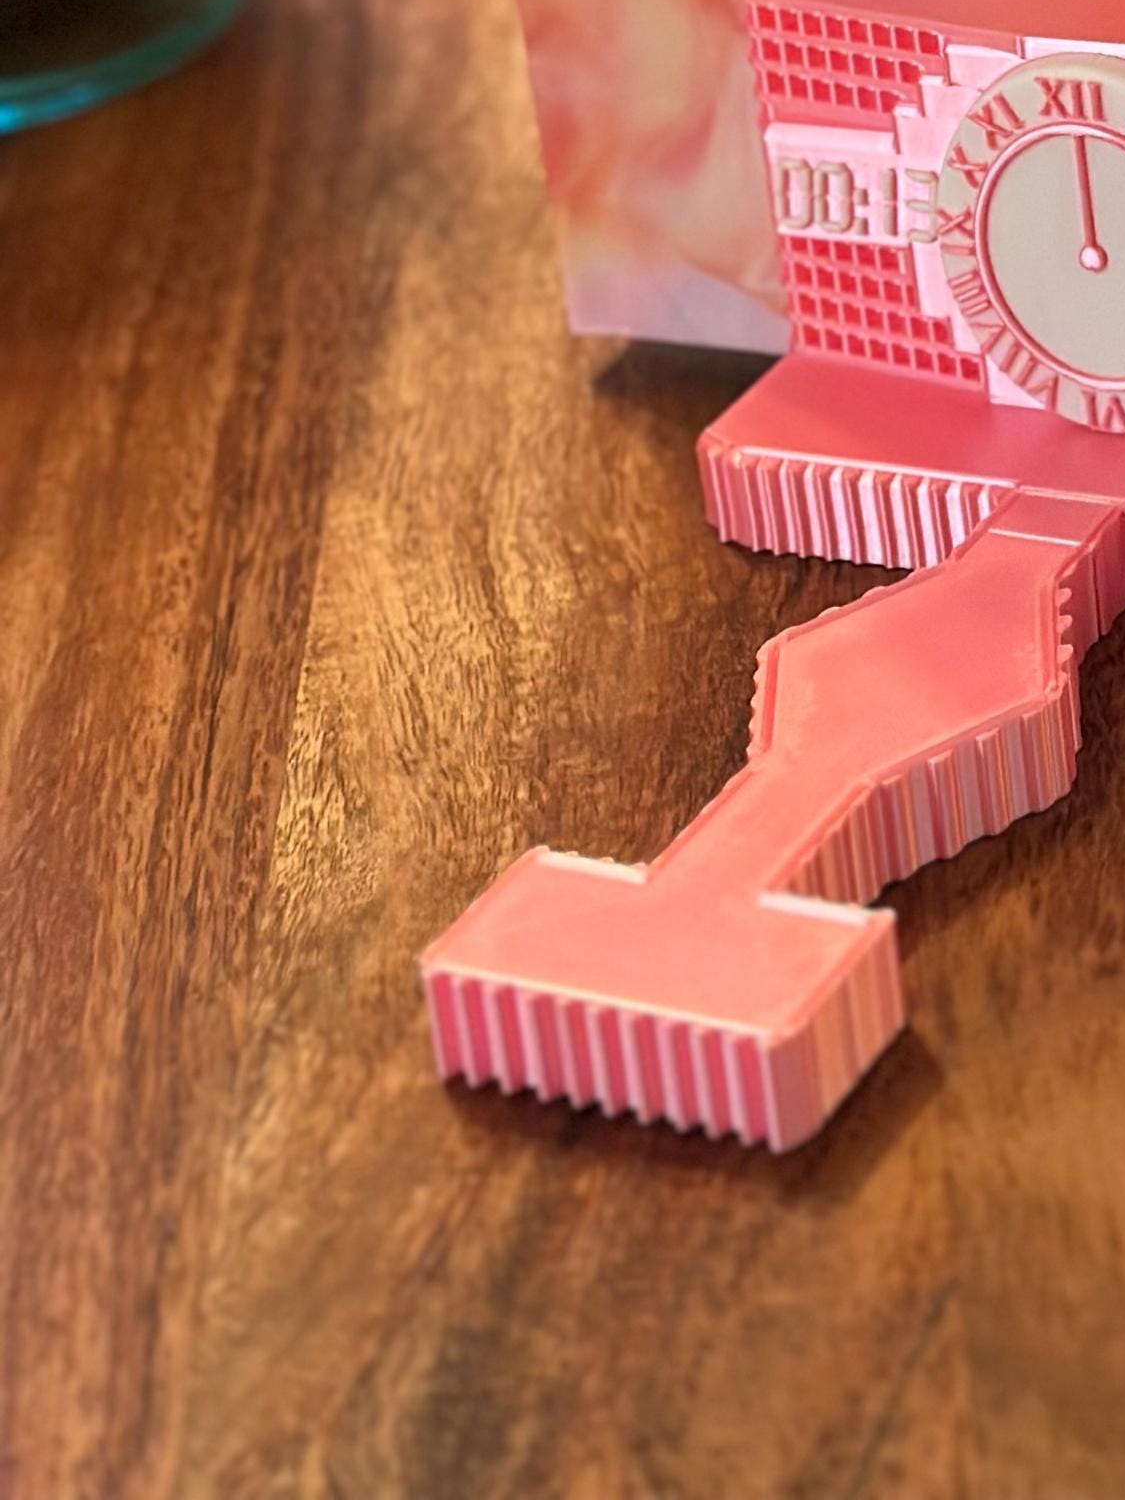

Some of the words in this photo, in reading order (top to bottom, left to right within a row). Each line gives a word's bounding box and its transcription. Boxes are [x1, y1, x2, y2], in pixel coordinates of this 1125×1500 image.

[967, 94, 1026, 150] XI
[1035, 77, 1106, 121] XII
[948, 143, 988, 188] X
[776, 157, 939, 243] 00:13
[937, 208, 976, 256] IX
[948, 269, 1007, 352] VIII
[1000, 340, 1059, 411] VII
